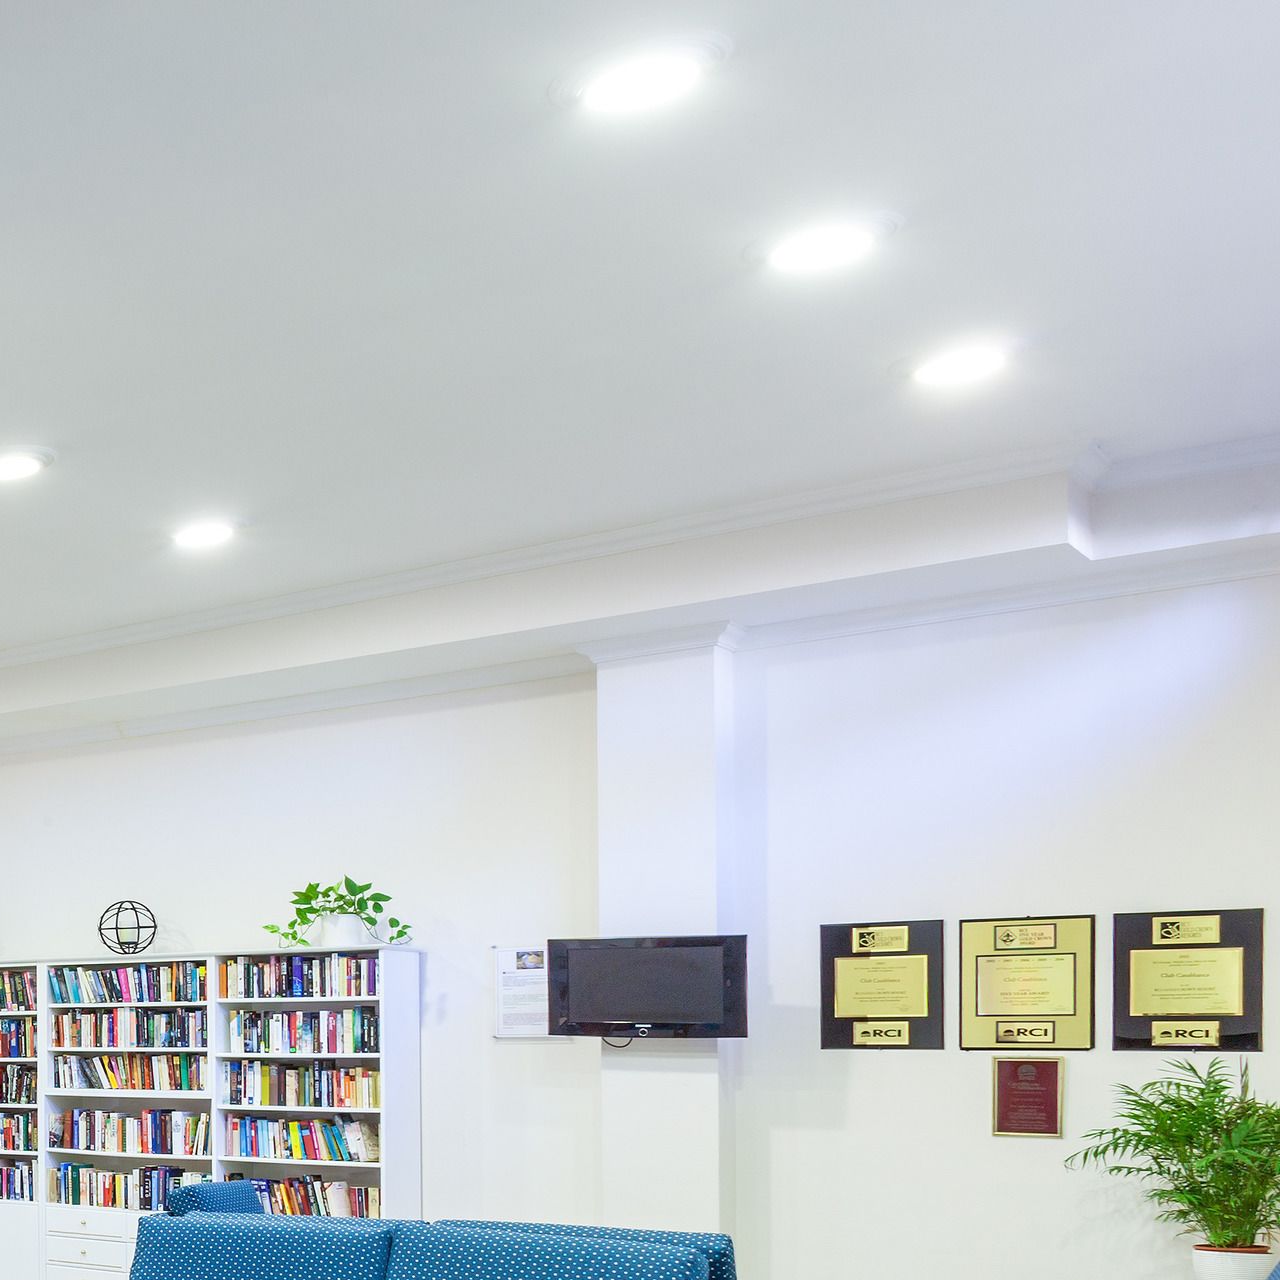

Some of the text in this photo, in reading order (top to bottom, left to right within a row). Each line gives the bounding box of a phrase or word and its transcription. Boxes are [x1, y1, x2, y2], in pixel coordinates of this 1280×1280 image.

[872, 1029, 902, 1038] RCI
[1016, 1028, 1048, 1037] RCI
[1174, 1029, 1210, 1039] RCI
